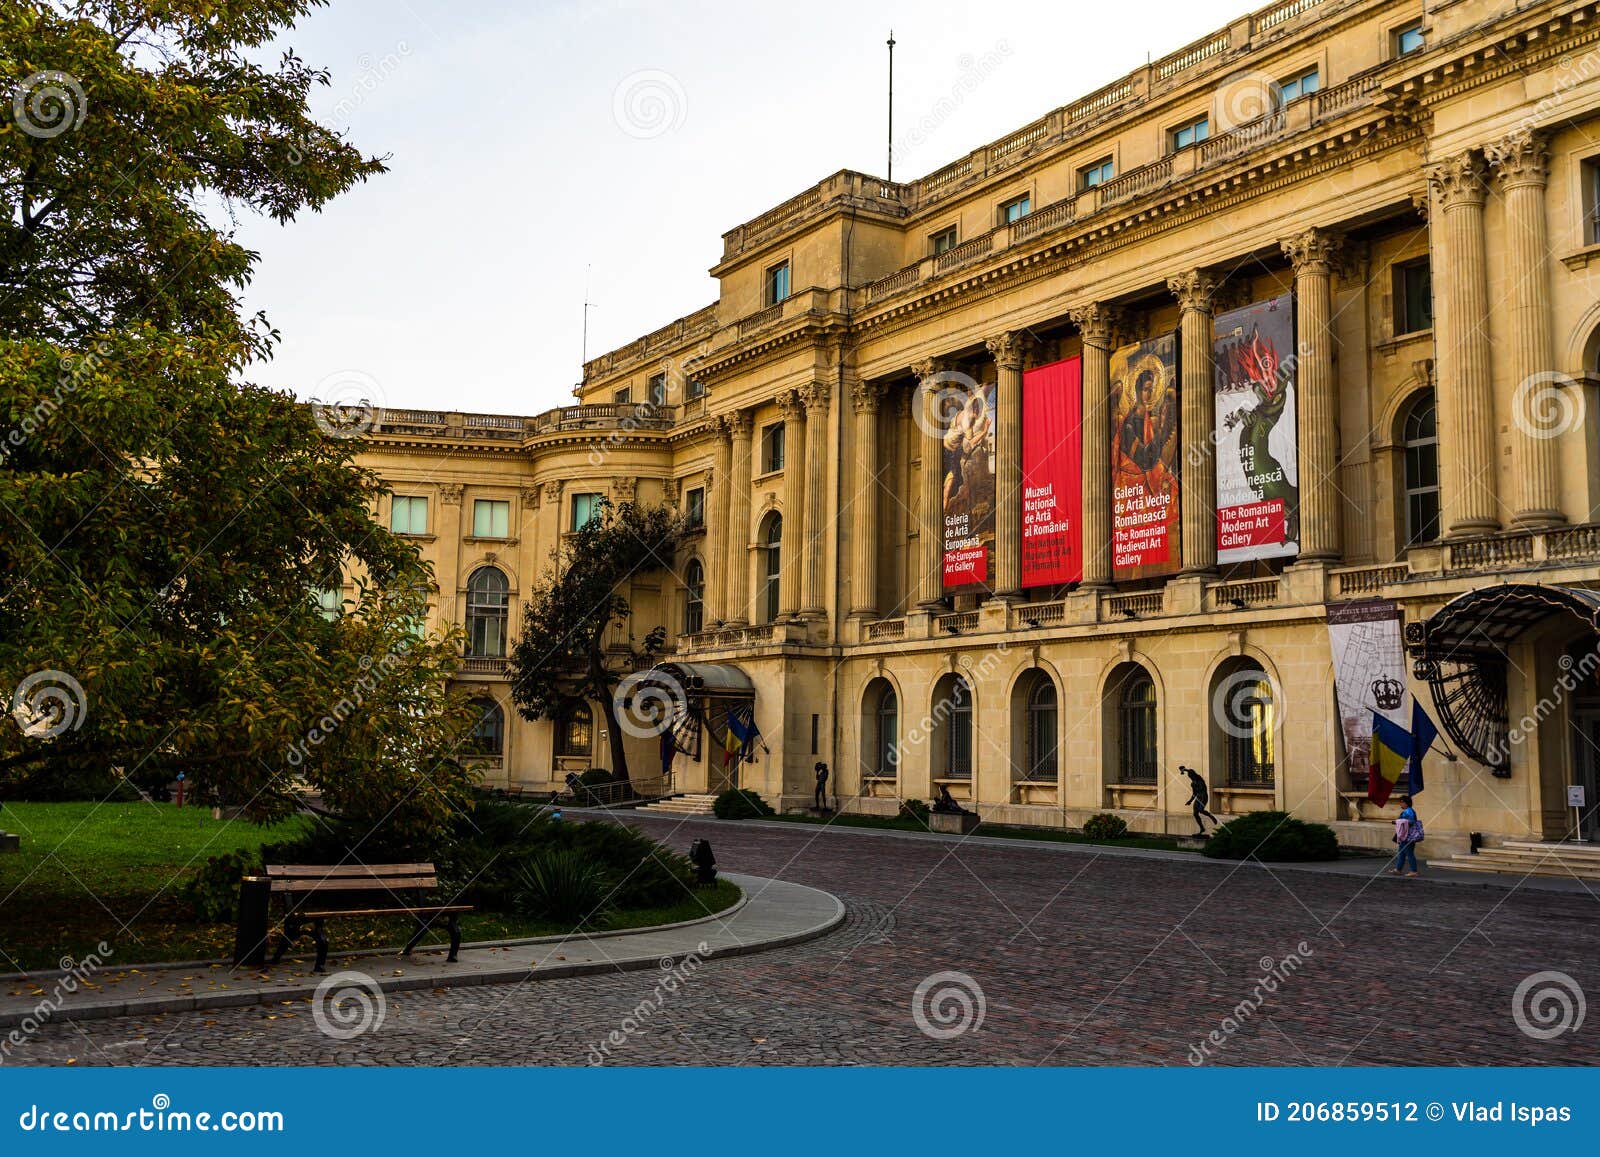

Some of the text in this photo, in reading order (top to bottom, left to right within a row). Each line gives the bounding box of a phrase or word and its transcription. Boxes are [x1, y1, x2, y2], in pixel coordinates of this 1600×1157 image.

[1025, 483, 1052, 499] Muzeul
[1114, 483, 1144, 500] Galeria
[1114, 492, 1171, 514] de Artă Veche
[1024, 509, 1051, 524] de Artă
[1114, 506, 1167, 528] Românească
[1221, 502, 1282, 521] The Romanian
[945, 513, 969, 527] Galeria
[1024, 519, 1069, 537] al României
[1221, 516, 1269, 534] Modern Art
[945, 524, 969, 538] de Artă
[1115, 525, 1166, 542] The Romanian
[945, 534, 980, 550] Europeană
[1115, 537, 1161, 554] Medieval Art
[1221, 533, 1252, 546] Gallery
[945, 550, 983, 562] The European
[1115, 553, 1142, 566] Gallery
[945, 561, 975, 574] Art Gallery
